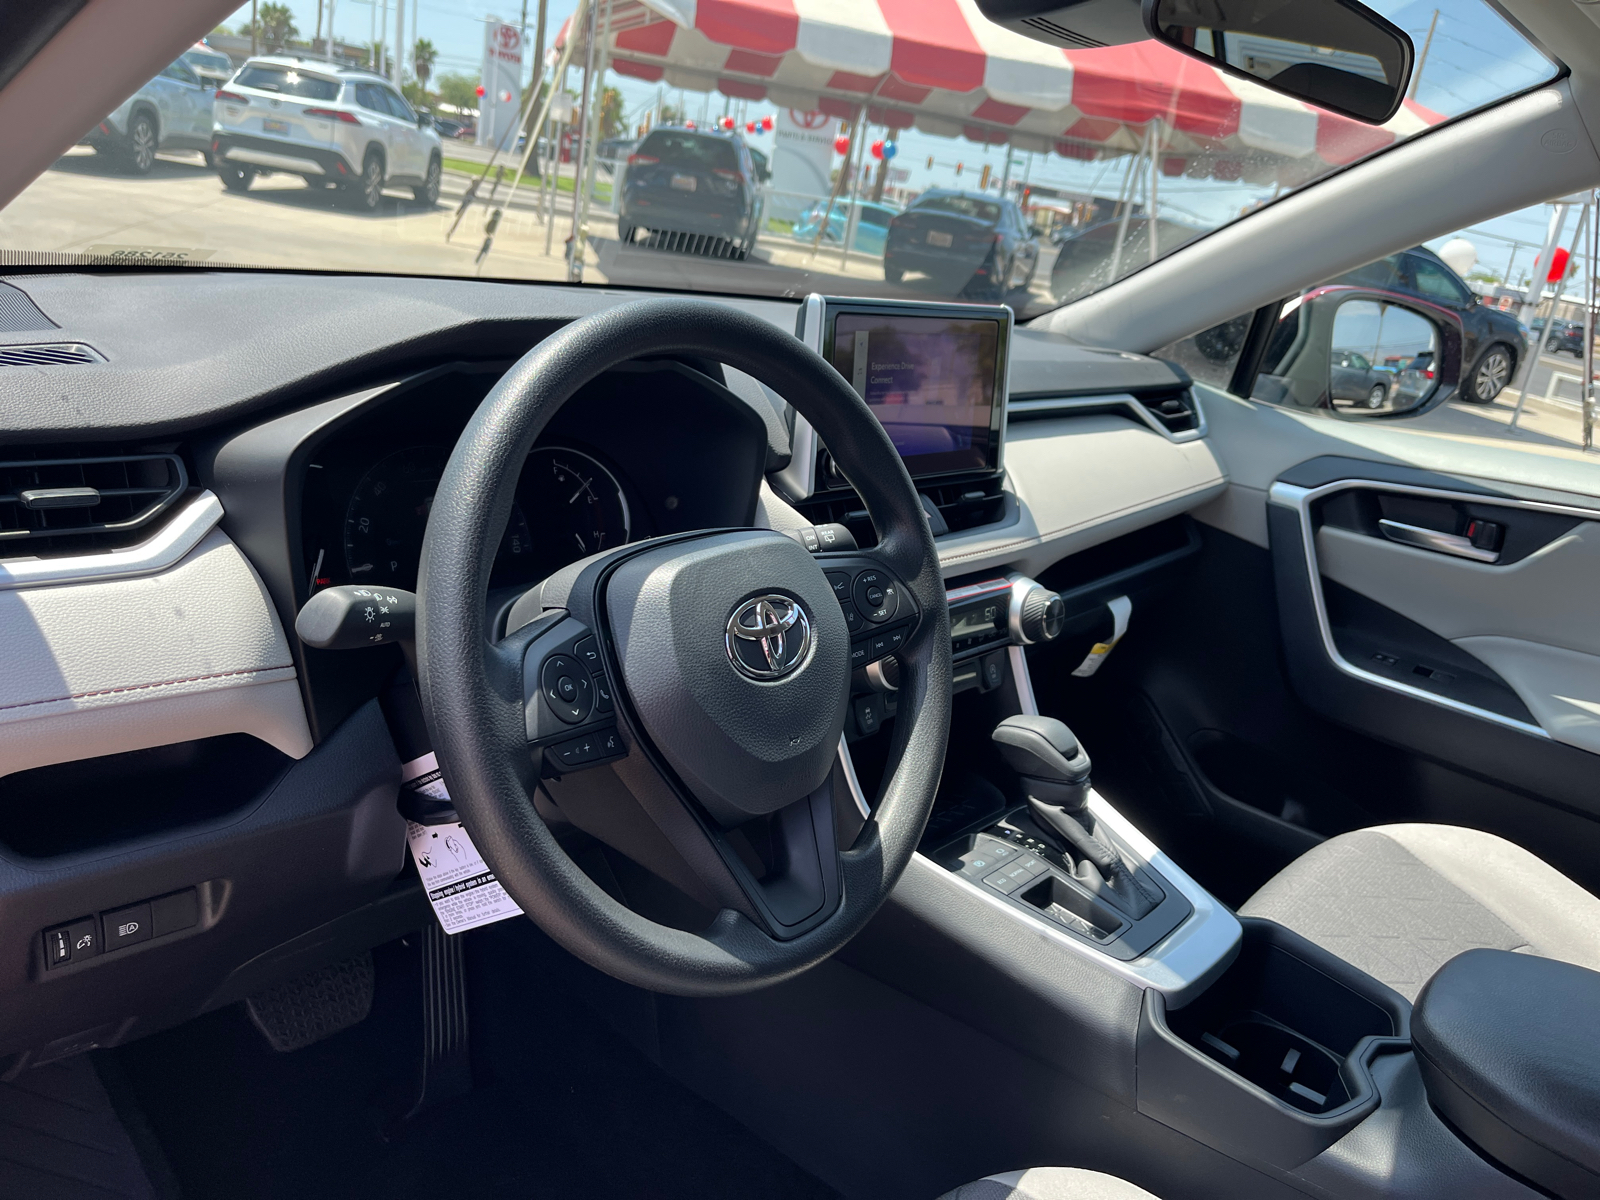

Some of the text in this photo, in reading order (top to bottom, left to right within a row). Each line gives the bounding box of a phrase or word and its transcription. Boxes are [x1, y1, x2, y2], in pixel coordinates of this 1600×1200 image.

[871, 362, 915, 371] Experience Drive
[870, 376, 893, 384] Connect
[358, 517, 370, 534] 20
[511, 533, 522, 554] 140
[390, 560, 398, 572] P
[564, 684, 574, 692] OK
